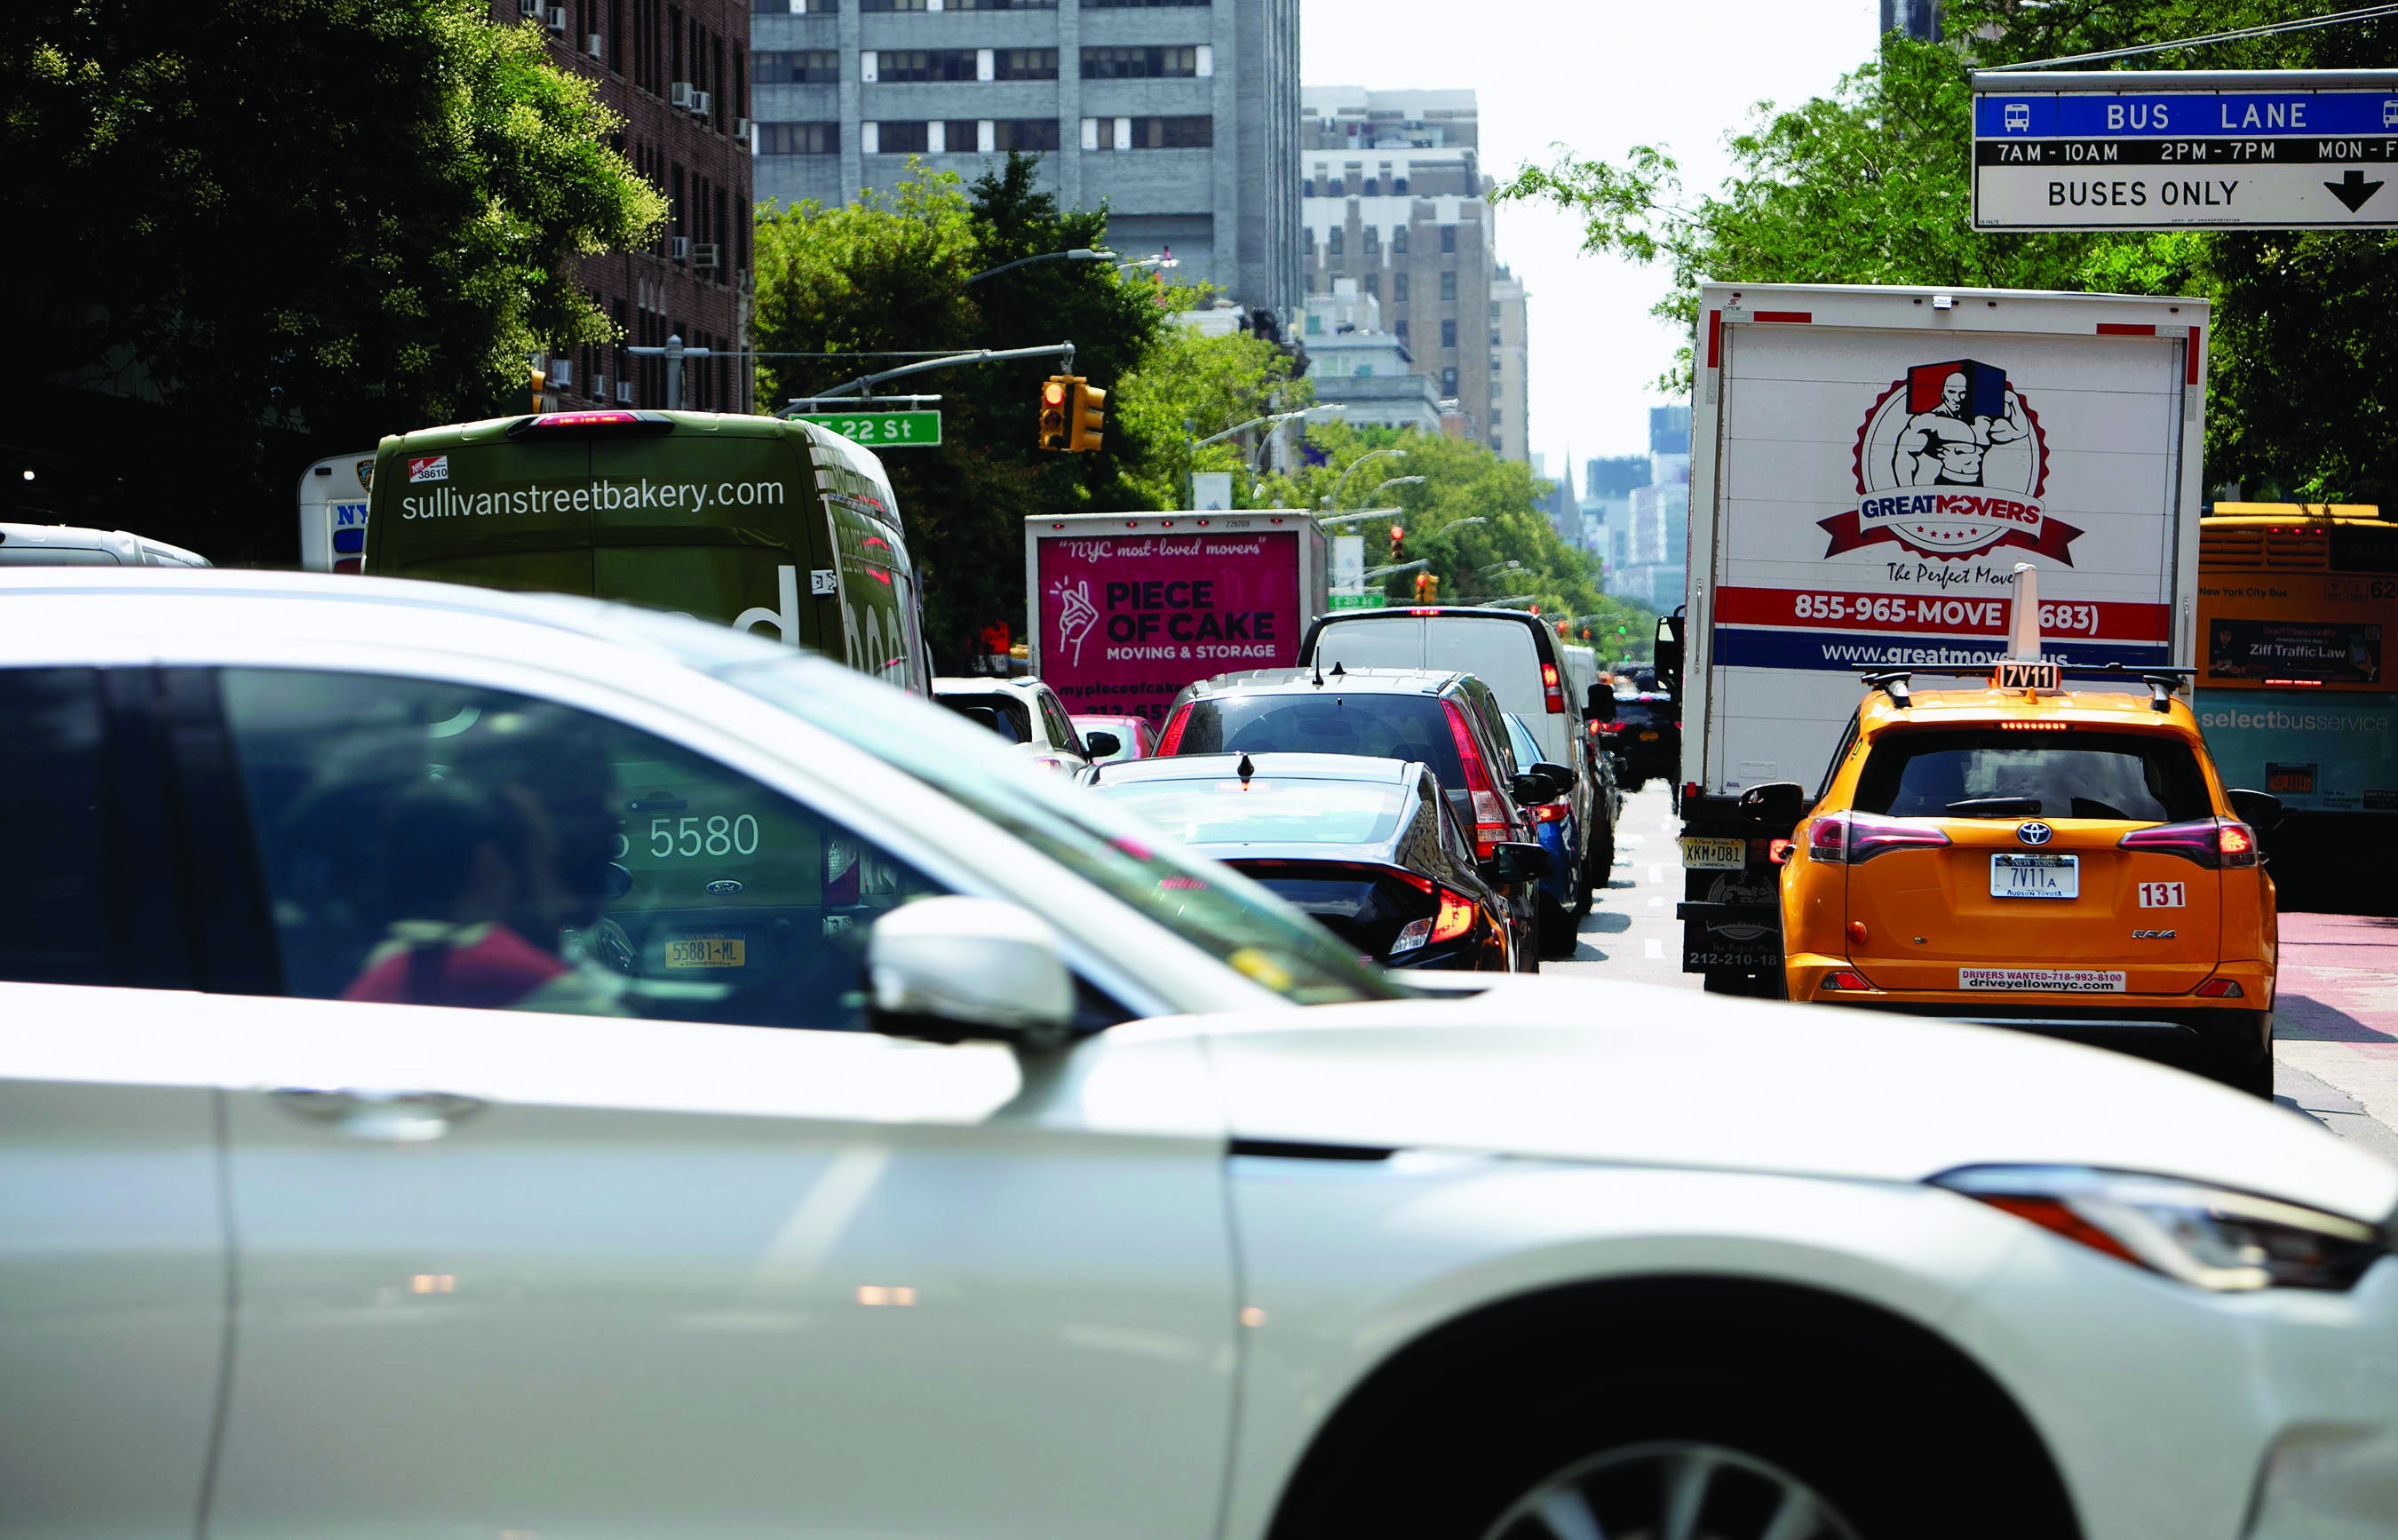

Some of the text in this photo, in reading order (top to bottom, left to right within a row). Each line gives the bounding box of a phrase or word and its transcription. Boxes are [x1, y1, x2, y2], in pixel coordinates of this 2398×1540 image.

[2108, 102, 2307, 130] BUS LANE
[2049, 180, 2239, 206] BUSES ONLY
[842, 420, 874, 439] 22
[884, 418, 911, 438] St
[418, 469, 448, 479] 38610
[402, 477, 784, 520] sullivanstreetbakery.com
[337, 504, 367, 525] NY
[1117, 538, 1201, 558] most-loved
[1887, 562, 2014, 590] The Perfect Move
[1107, 581, 1213, 610] PIECE
[2199, 587, 2288, 600] New York City Bus
[2370, 581, 2398, 599] 62
[1794, 595, 2099, 636] 855-965-MOVE 683)
[1107, 612, 1275, 643] OF CAKE
[1107, 645, 1275, 661] MOVING & STORAGE
[1822, 645, 2068, 665] www.greatmoveus
[2250, 644, 2346, 659] Ziff Traffic Law
[2005, 665, 2050, 687] 7V11
[650, 814, 759, 858] 5580
[2141, 883, 2183, 906] 131
[1689, 952, 1777, 966] 212-210-18
[1963, 971, 2005, 980] DRIVERS
[1969, 978, 2114, 990] driveyellownyc.com
